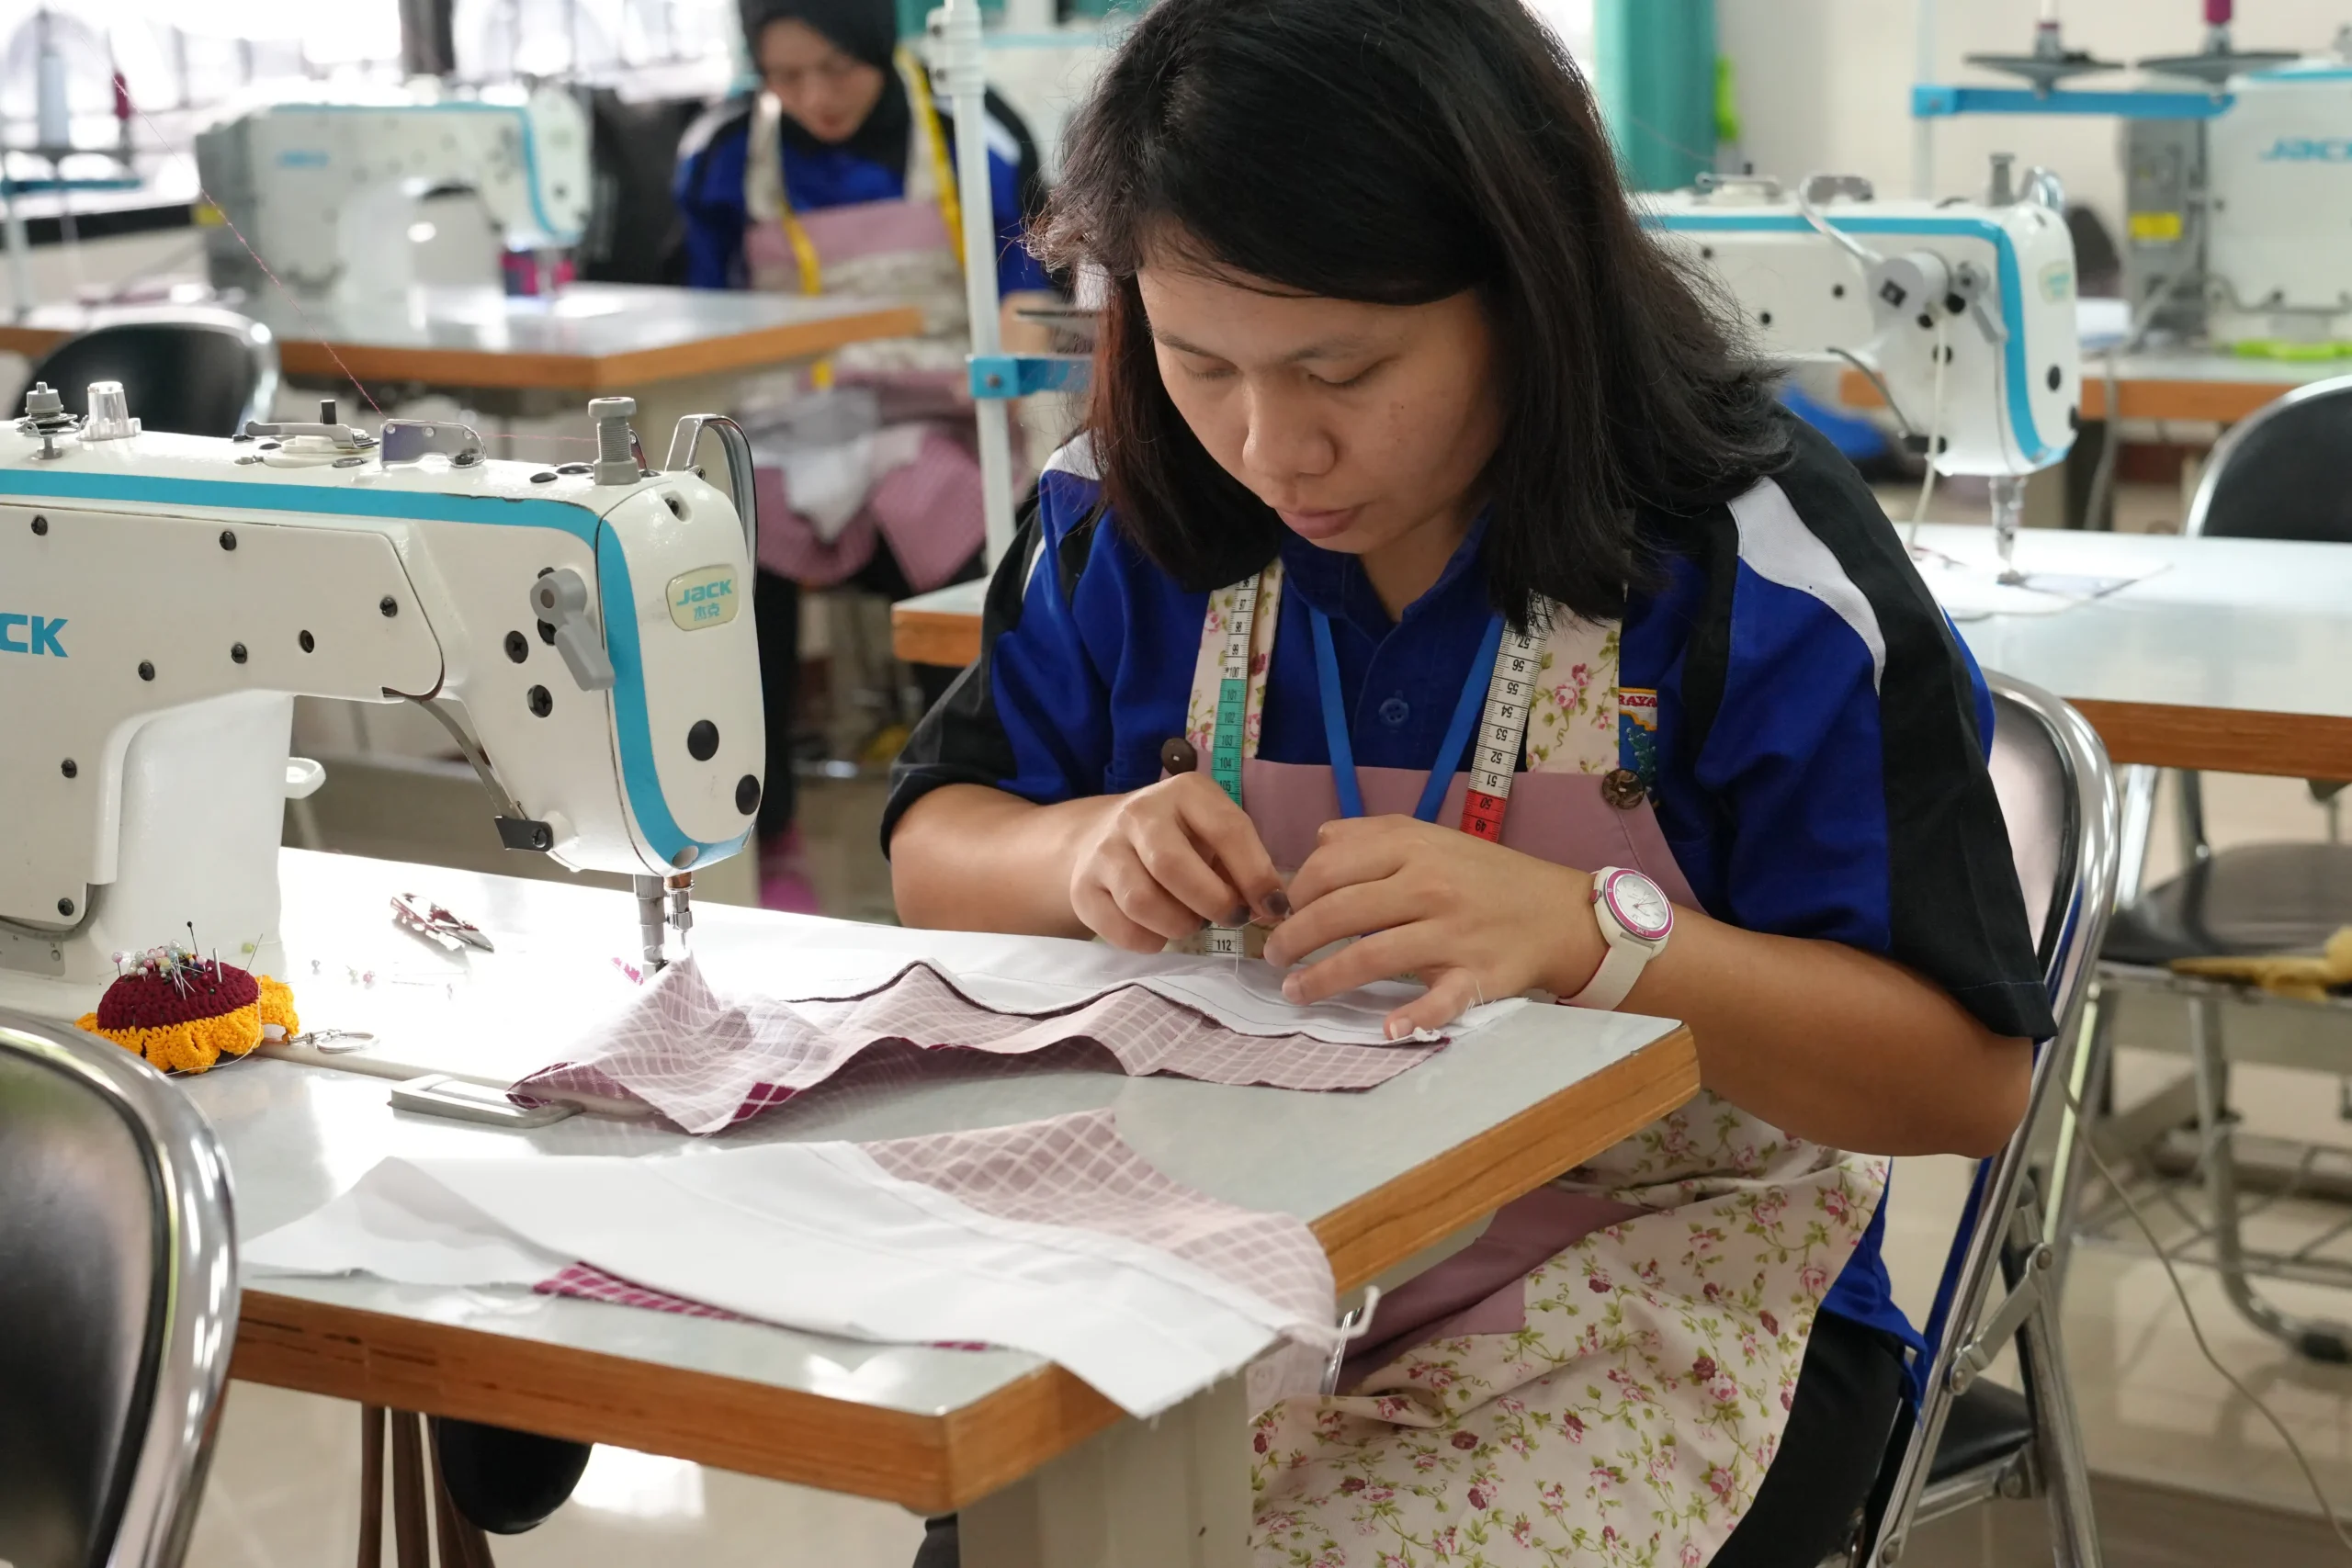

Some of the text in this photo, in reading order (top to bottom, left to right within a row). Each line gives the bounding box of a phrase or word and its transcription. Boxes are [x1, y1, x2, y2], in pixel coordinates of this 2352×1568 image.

[1239, 599, 1247, 610] 97
[1235, 622, 1242, 632] 98
[0, 612, 69, 658] CK
[1232, 644, 1238, 655] 99
[1511, 659, 1525, 672] 56
[1227, 689, 1237, 700] 101
[1506, 682, 1520, 695] 55
[1225, 713, 1235, 723] 102
[1501, 705, 1514, 718] 54
[1221, 735, 1233, 746] 103
[1495, 728, 1509, 741] 53
[1219, 757, 1232, 769] 104
[1489, 750, 1503, 764] 52
[1486, 773, 1498, 787] 51
[1479, 796, 1493, 809] 50
[1475, 818, 1487, 832] 49
[1216, 940, 1231, 951] 112
